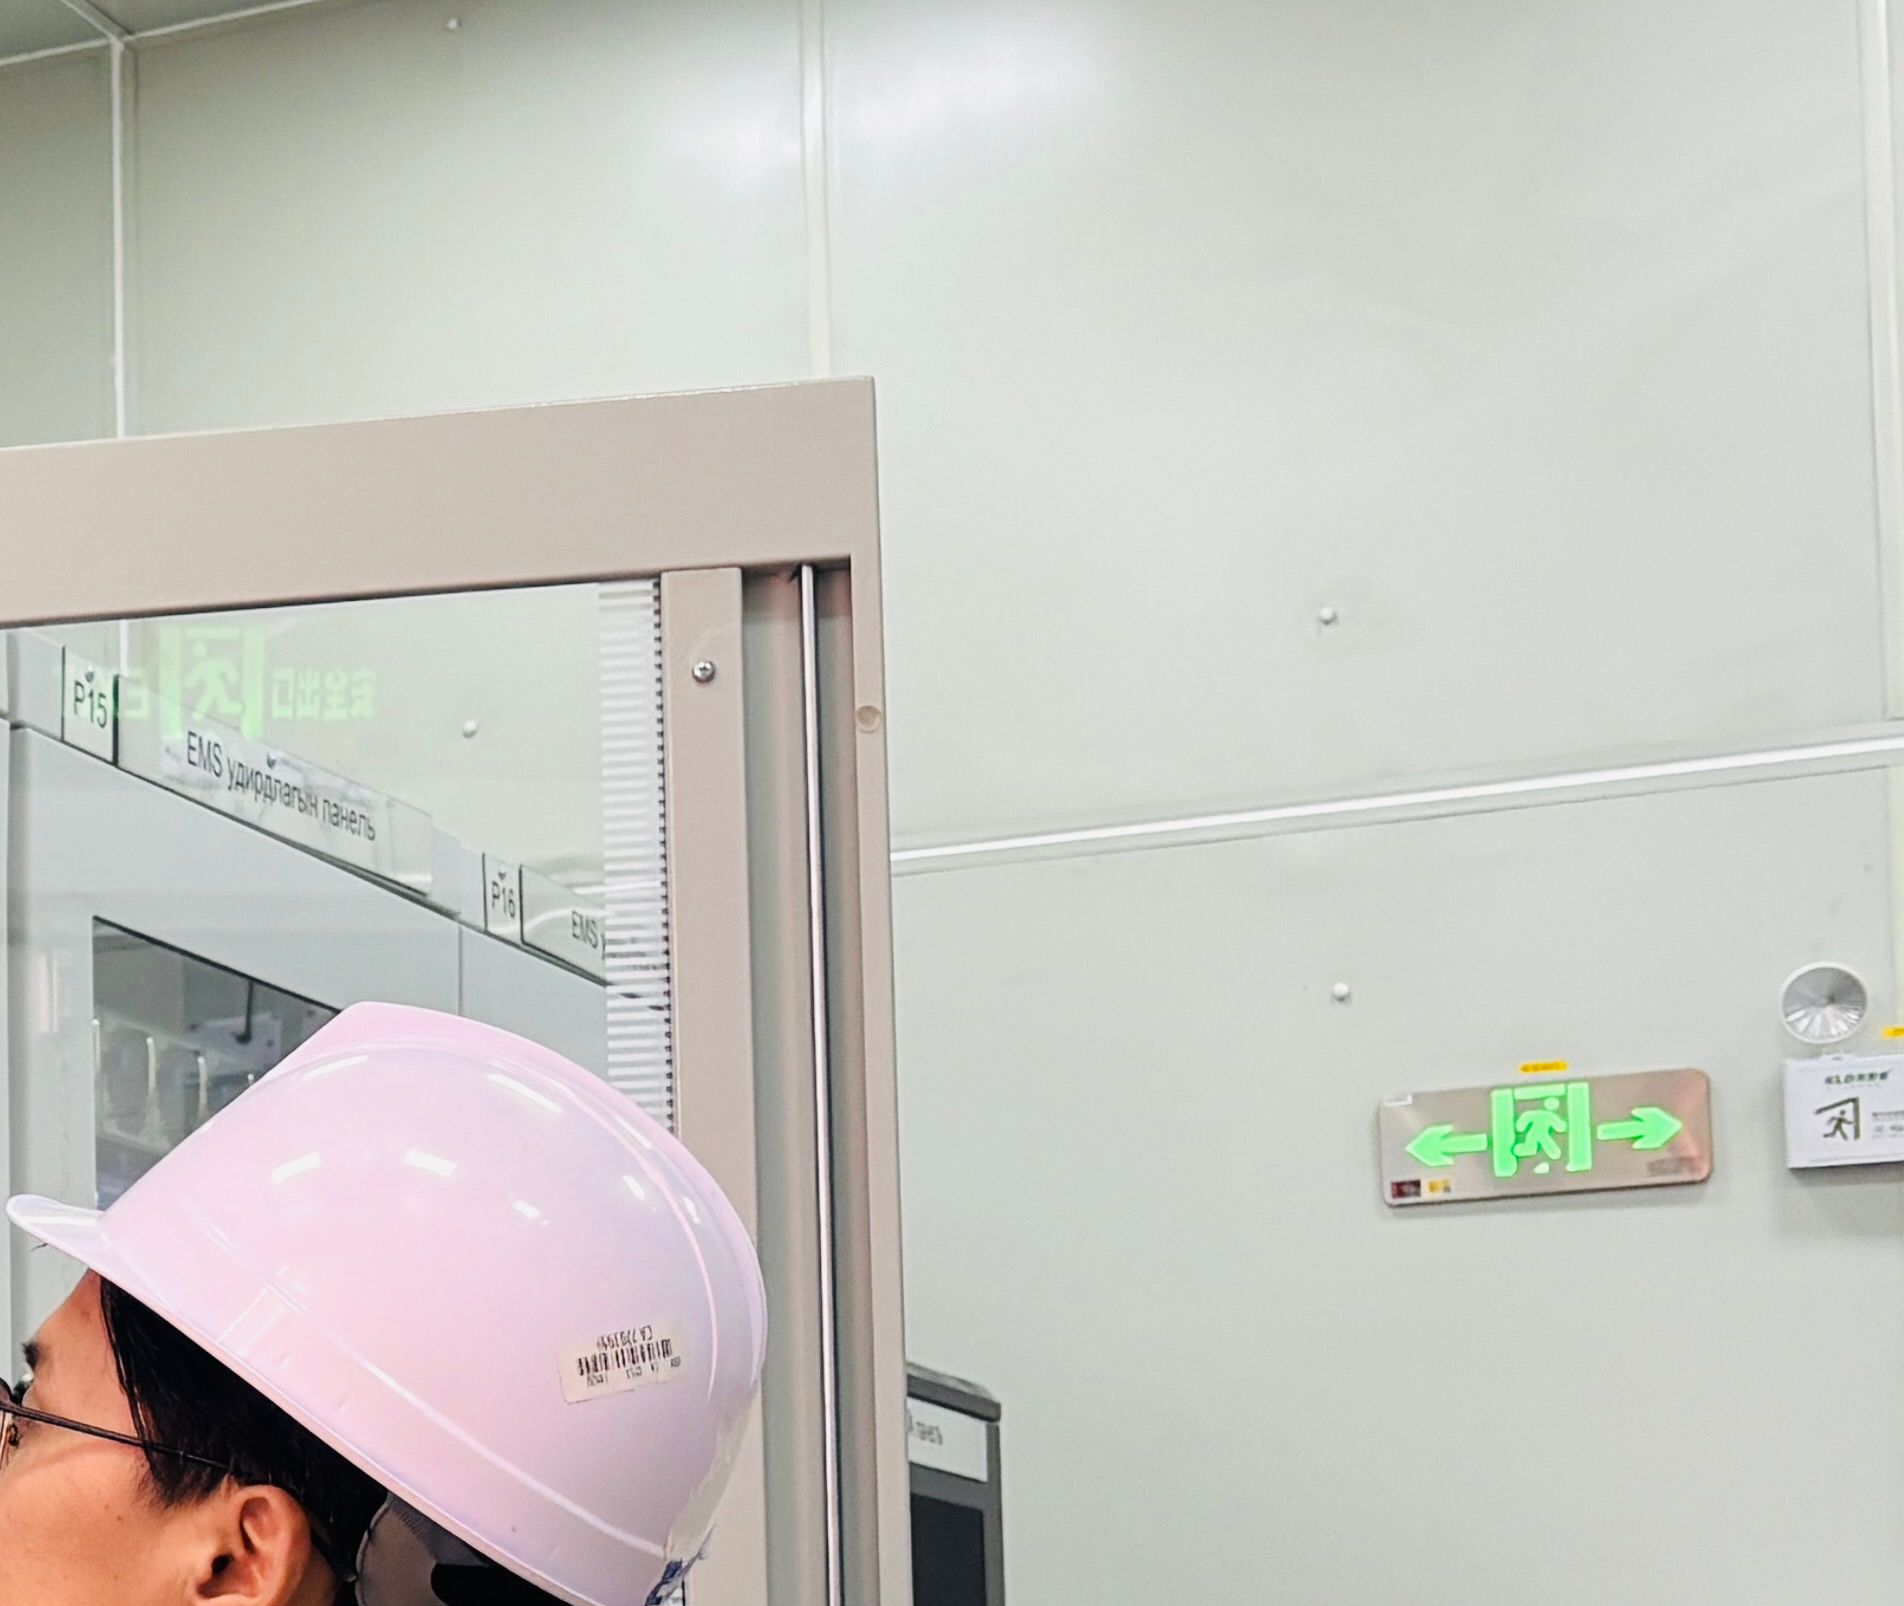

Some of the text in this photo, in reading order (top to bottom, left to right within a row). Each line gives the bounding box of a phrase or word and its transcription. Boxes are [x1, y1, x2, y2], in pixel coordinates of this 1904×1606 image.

[73, 680, 108, 728] P15
[187, 731, 223, 778] EMS
[323, 798, 377, 842] панель
[492, 880, 516, 919] P16
